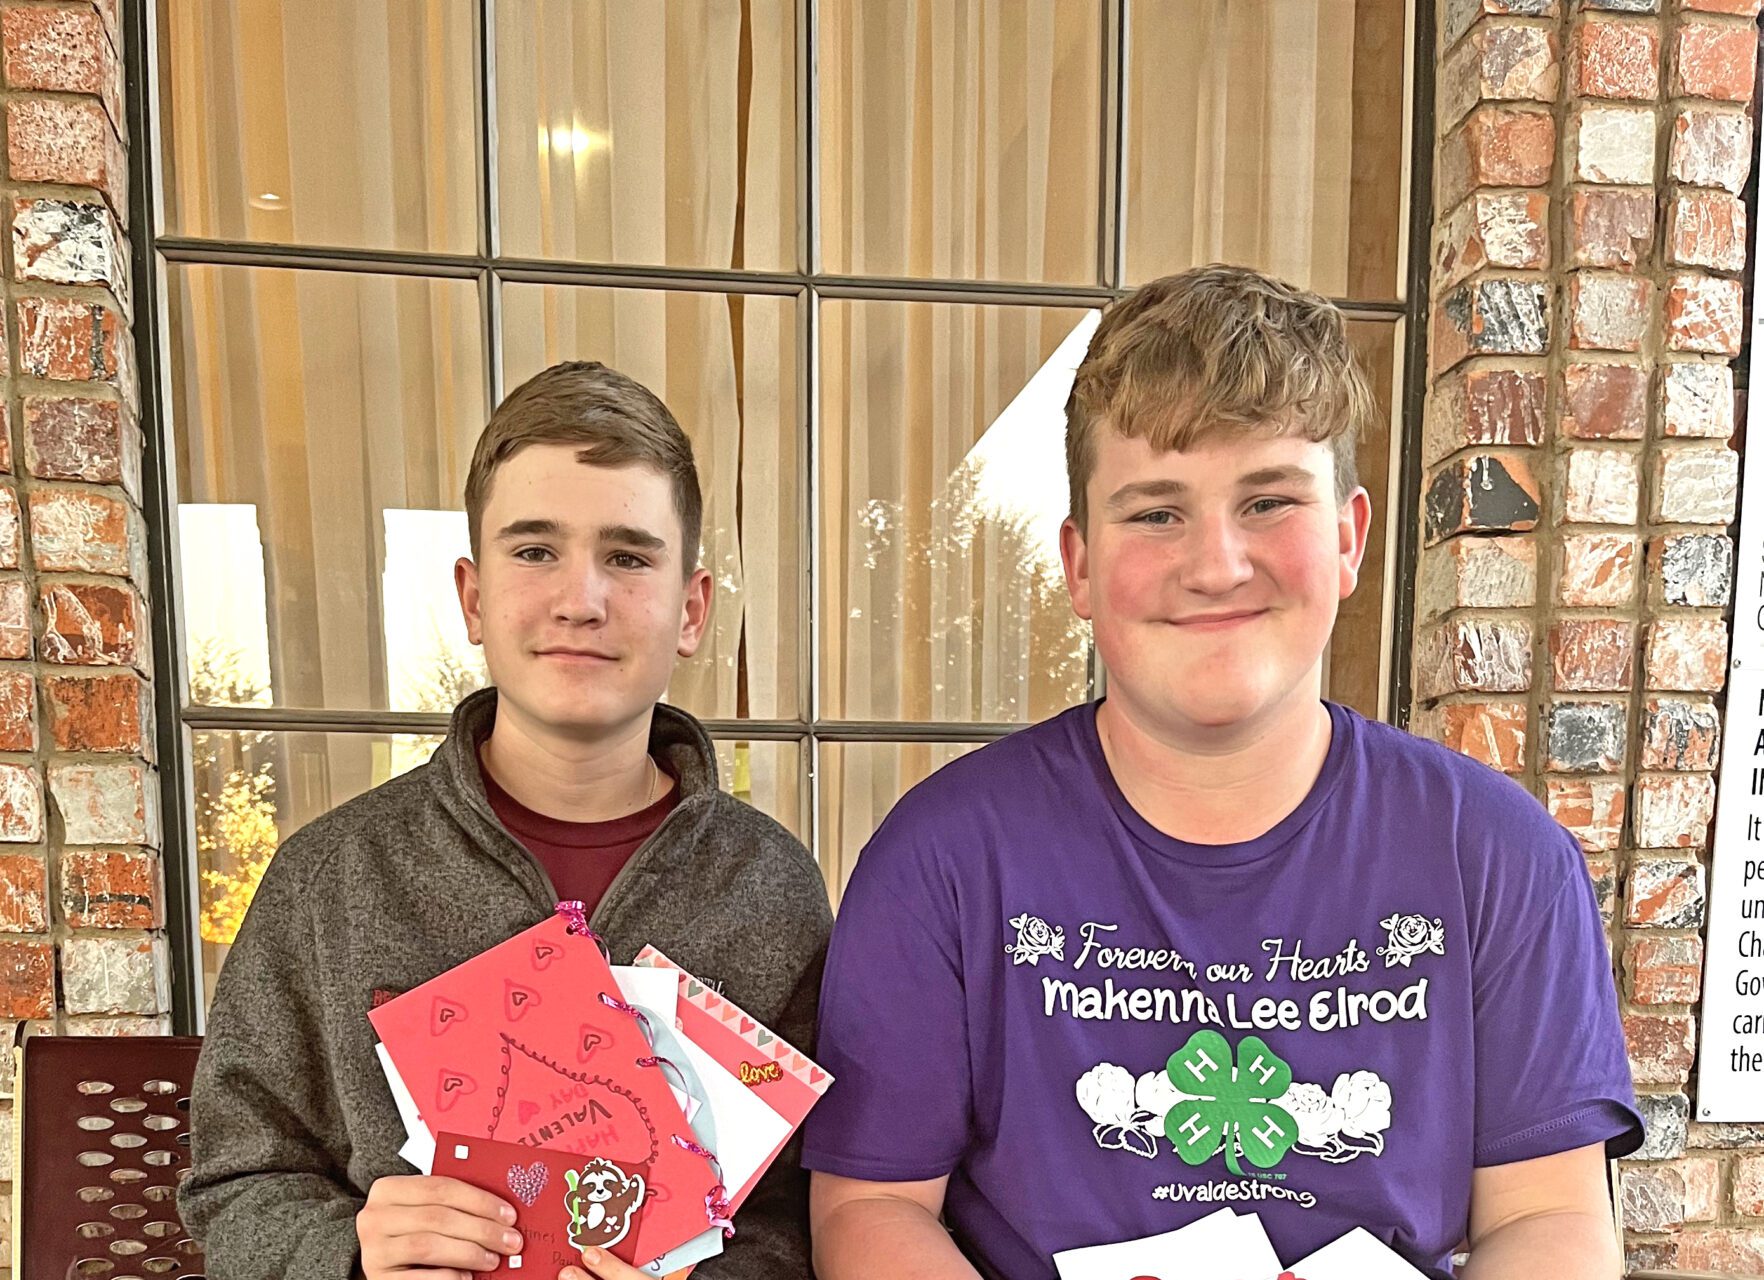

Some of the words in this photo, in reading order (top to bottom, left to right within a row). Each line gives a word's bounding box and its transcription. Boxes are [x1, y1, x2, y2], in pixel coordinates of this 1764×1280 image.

[1747, 813, 1762, 841] It
[1738, 930, 1764, 958] Ch
[1206, 963, 1253, 982] our
[1261, 939, 1370, 982] Hearts
[1735, 969, 1764, 996] Go
[1226, 993, 1302, 1031] Lee
[1308, 977, 1429, 1032] Elrod
[1732, 1014, 1764, 1034] car
[740, 1061, 781, 1084] love
[1184, 1048, 1219, 1083] H
[1248, 1054, 1277, 1086] H
[1730, 1045, 1763, 1072] the
[517, 1098, 613, 1148] VALENTI
[1178, 1112, 1211, 1146] H
[1251, 1115, 1285, 1150] H
[1152, 1179, 1317, 1209] #UvaldeStrong
